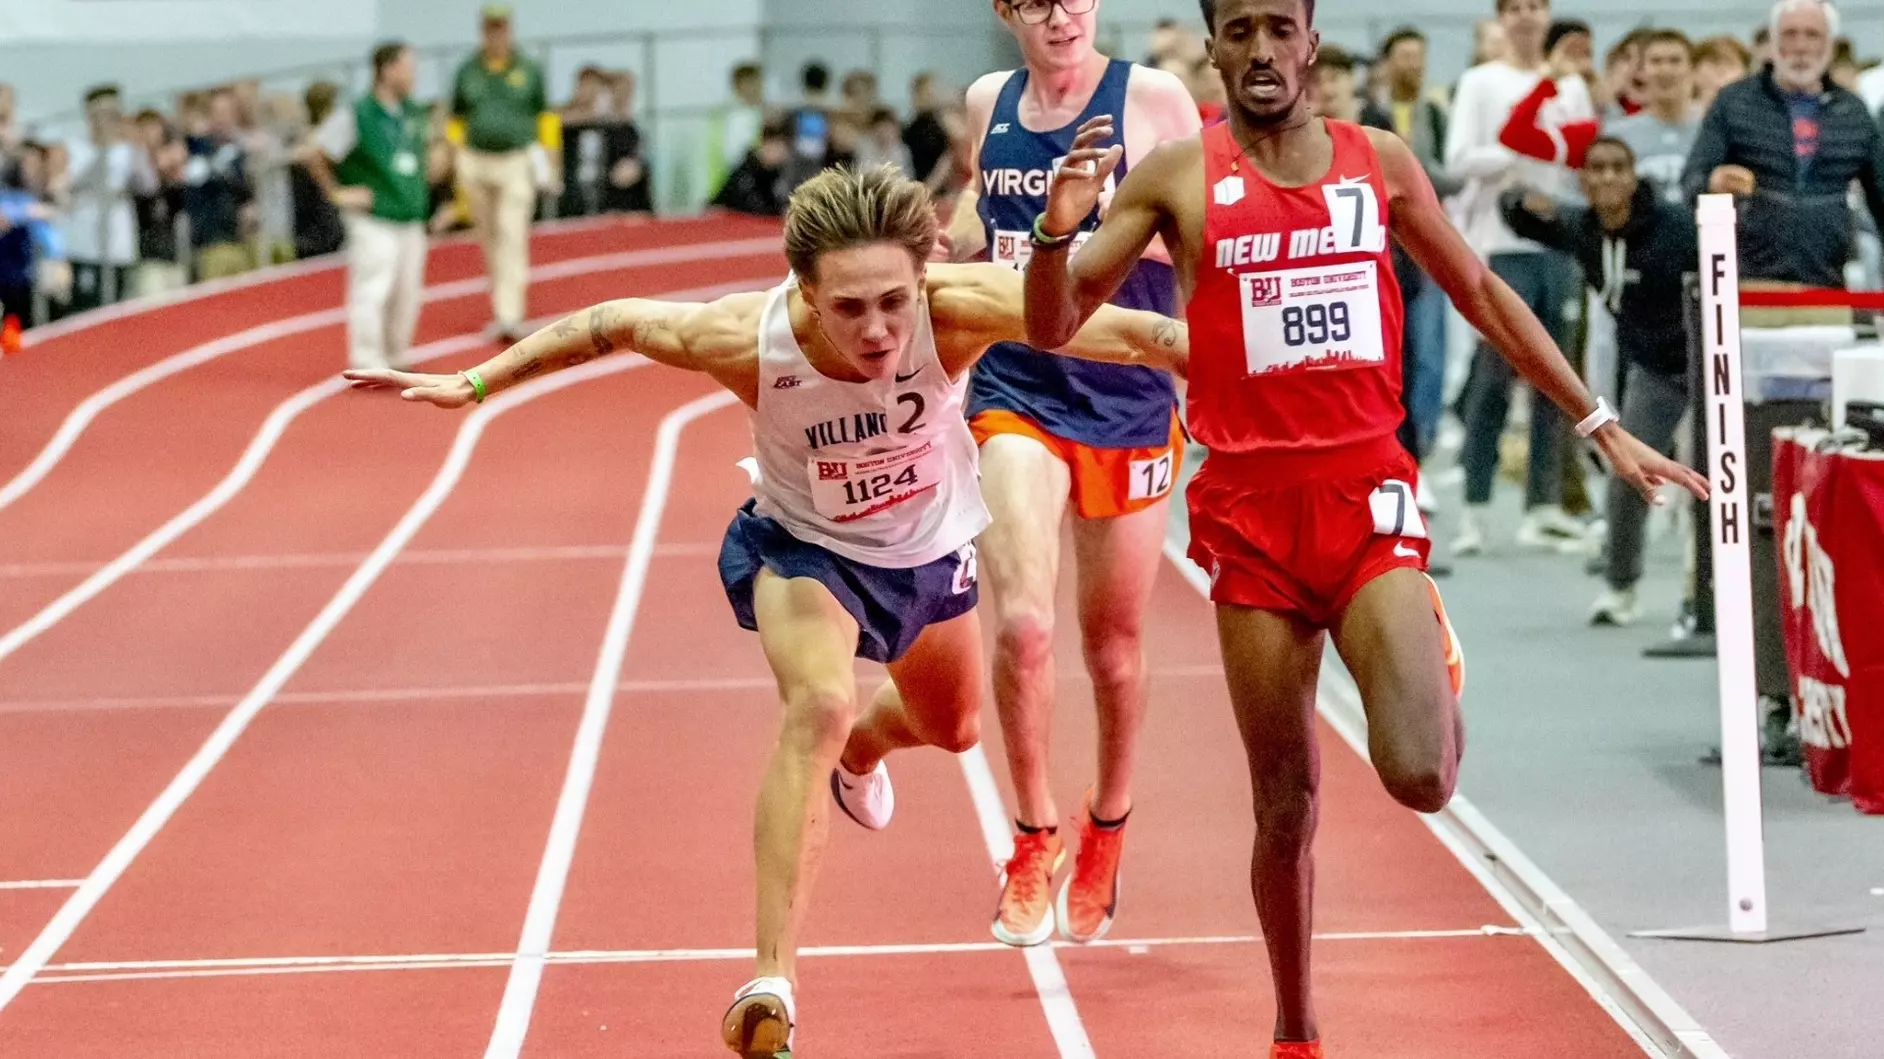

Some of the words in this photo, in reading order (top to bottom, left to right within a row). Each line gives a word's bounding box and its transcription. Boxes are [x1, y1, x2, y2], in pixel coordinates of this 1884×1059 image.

[982, 168, 1053, 196] VIRGI
[1335, 187, 1364, 248] 7
[1215, 232, 1282, 268] NEW
[1287, 226, 1336, 260] ME
[1250, 277, 1281, 303] BU
[1282, 301, 1351, 346] 899
[896, 391, 926, 434] 2
[1711, 253, 1739, 544] FINISH
[817, 462, 848, 478] BU
[856, 459, 884, 469] BOSTON
[887, 441, 932, 463] UNIVERSITY
[842, 464, 918, 505] 1124
[1142, 456, 1169, 496] 12
[1378, 484, 1405, 536] 7
